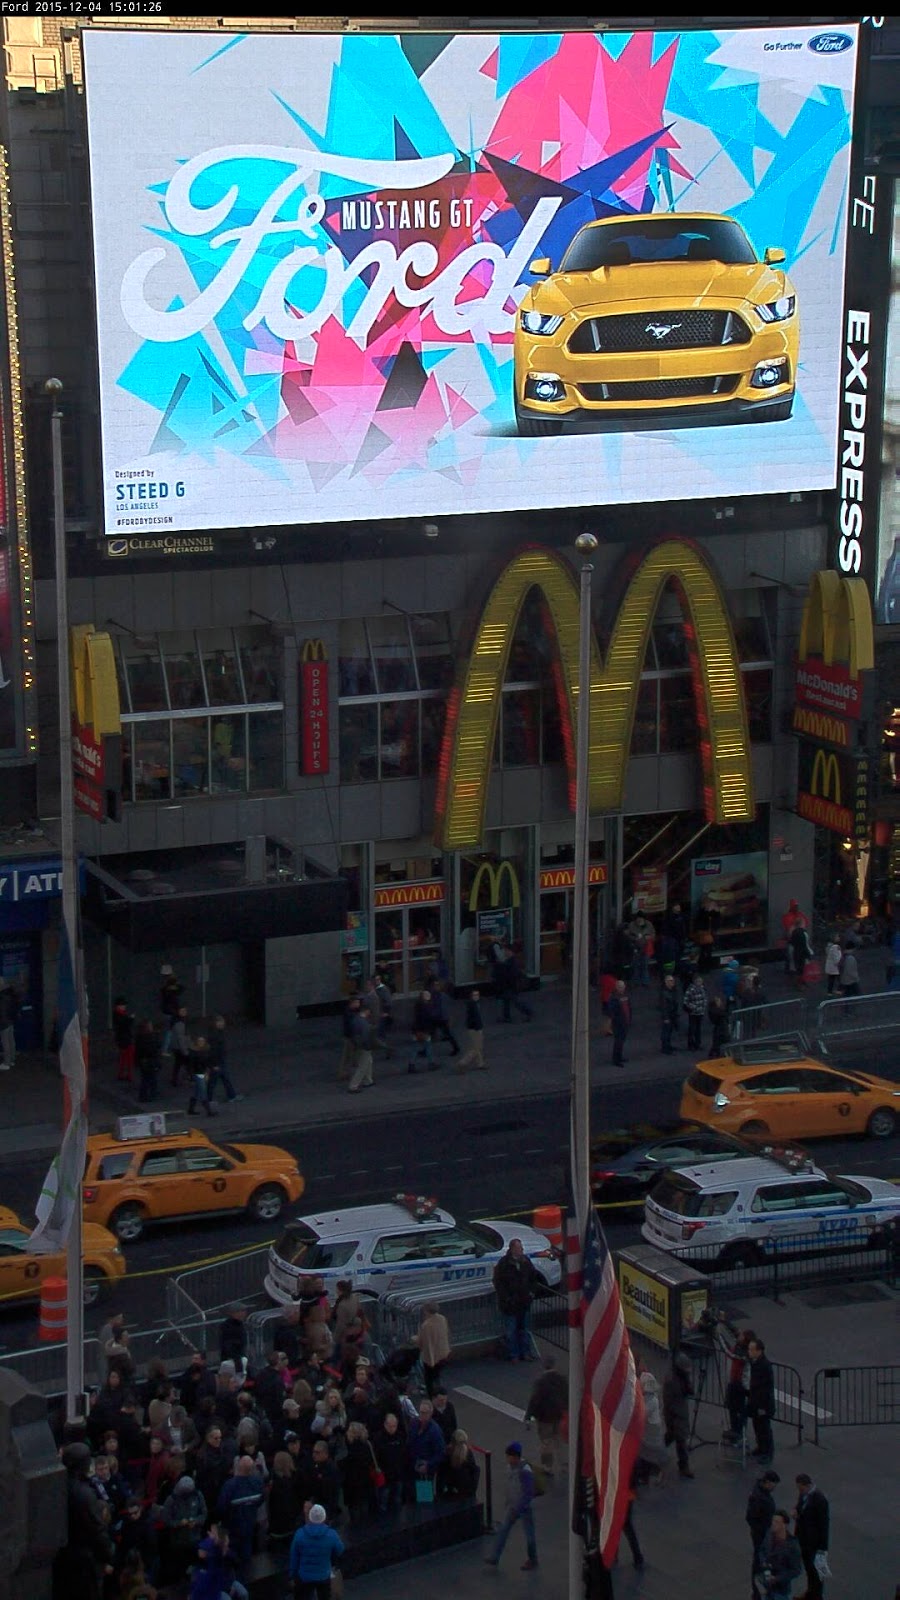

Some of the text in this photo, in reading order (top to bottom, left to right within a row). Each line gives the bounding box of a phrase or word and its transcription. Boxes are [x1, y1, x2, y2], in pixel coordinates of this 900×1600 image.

[763, 42, 803, 51] Go Further
[815, 36, 845, 51] Ford
[342, 198, 474, 230] MUSTANG GT
[121, 146, 563, 348] Ford
[838, 309, 871, 574] EXPRESS
[115, 469, 155, 479] Designed by
[116, 481, 186, 501] STEED G
[116, 502, 159, 511] LOS ANGELES
[116, 516, 173, 526] #FORDBYDESIGN
[796, 669, 859, 702] McDonald's
[309, 668, 324, 769] OPEN 24 HOURS
[23, 872, 64, 894] AT
[622, 1275, 666, 1319] Beautiful
